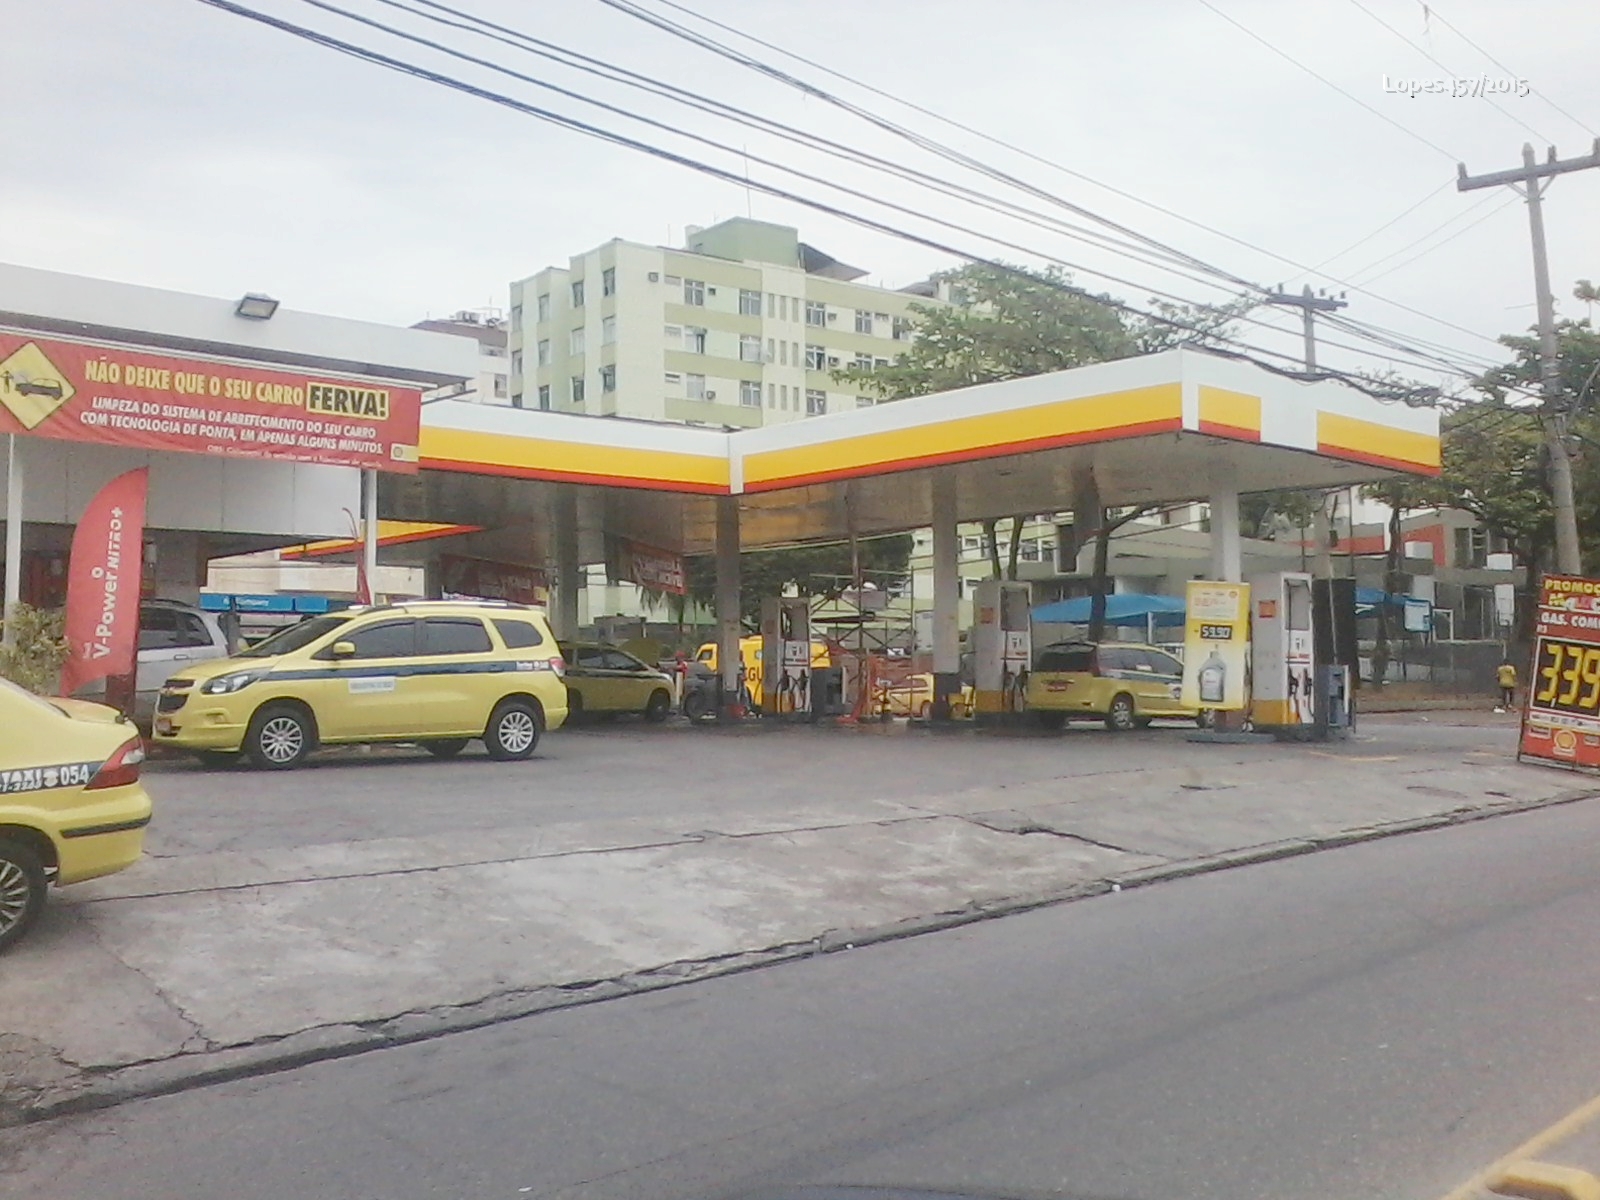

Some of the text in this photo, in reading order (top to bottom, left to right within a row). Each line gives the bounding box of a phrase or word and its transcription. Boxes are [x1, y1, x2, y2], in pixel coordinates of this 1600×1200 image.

[85, 357, 387, 417] NÃO DEIXE QUE O SEU CARRO FERVA!
[80, 412, 108, 426] COM
[110, 414, 181, 434] TECNOLOGIA
[183, 423, 196, 435] DE
[199, 424, 237, 441] PONTA,
[240, 430, 255, 441] EM
[257, 431, 296, 445] APENAS
[297, 435, 337, 449] ALGUNS
[92, 397, 139, 413] LIMPEZA
[142, 403, 160, 415] DO
[162, 405, 206, 421] SISTEMA
[208, 411, 222, 422] DE
[306, 421, 322, 433] DO
[324, 423, 342, 435] SEU
[344, 426, 376, 439] CARRO
[92, 570, 117, 659] V-Power
[1571, 615, 1600, 629] COM
[60, 764, 89, 786] 054
